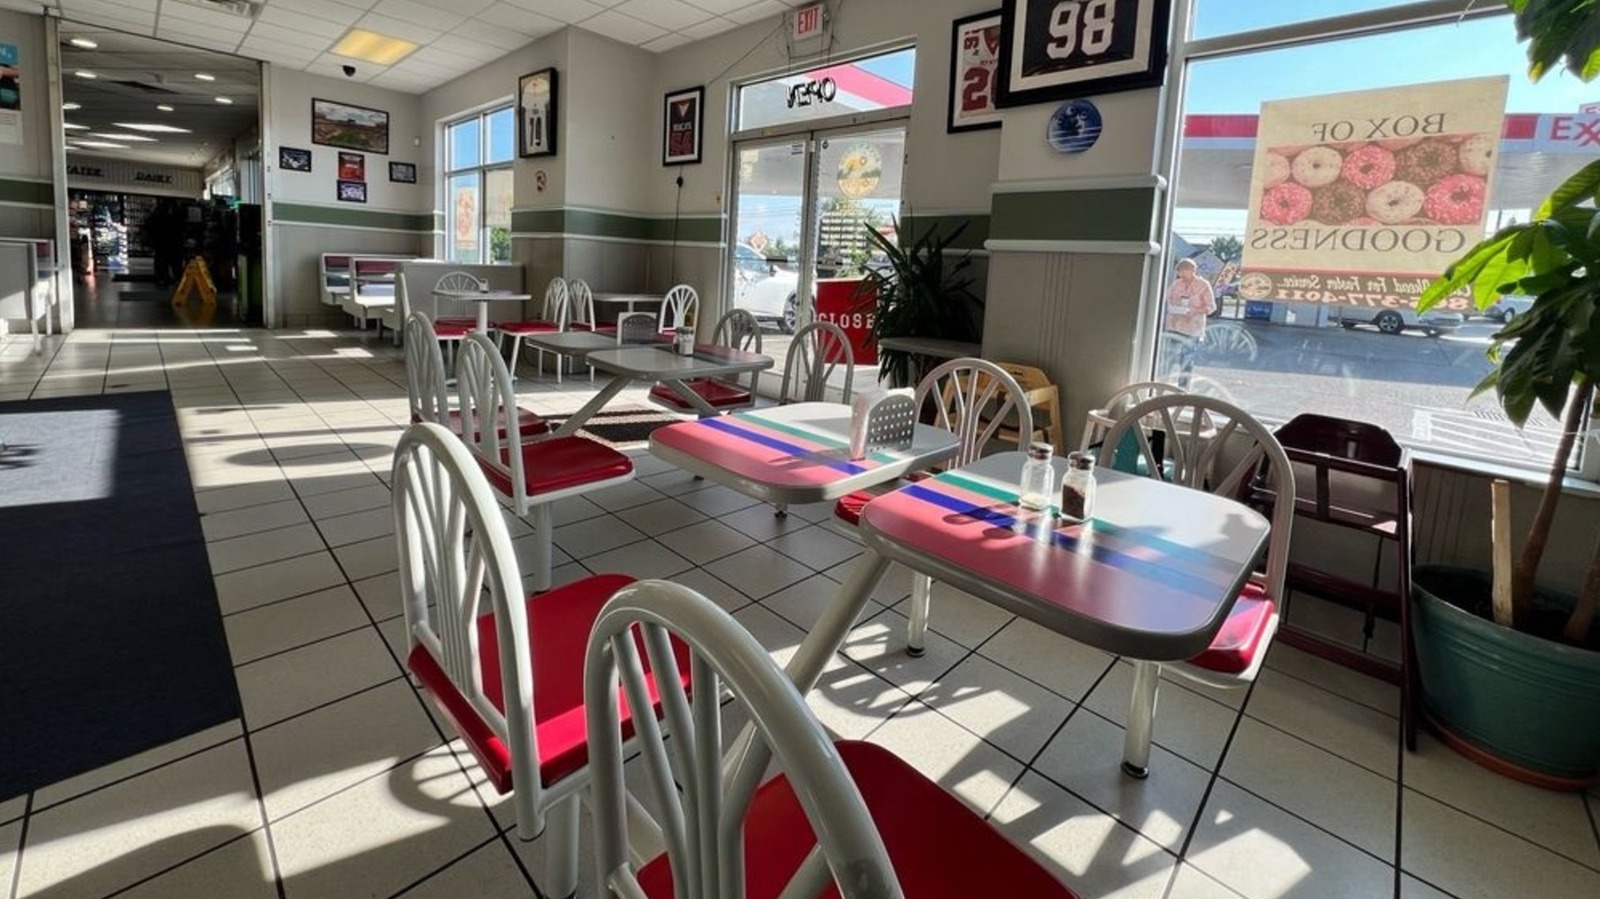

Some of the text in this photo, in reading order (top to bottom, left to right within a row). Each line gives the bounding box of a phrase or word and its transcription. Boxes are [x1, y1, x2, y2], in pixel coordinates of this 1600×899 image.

[798, 7, 818, 34] EXIT
[1046, 0, 1115, 60] 98
[67, 164, 104, 177] ATER
[135, 171, 174, 184] DAIRY
